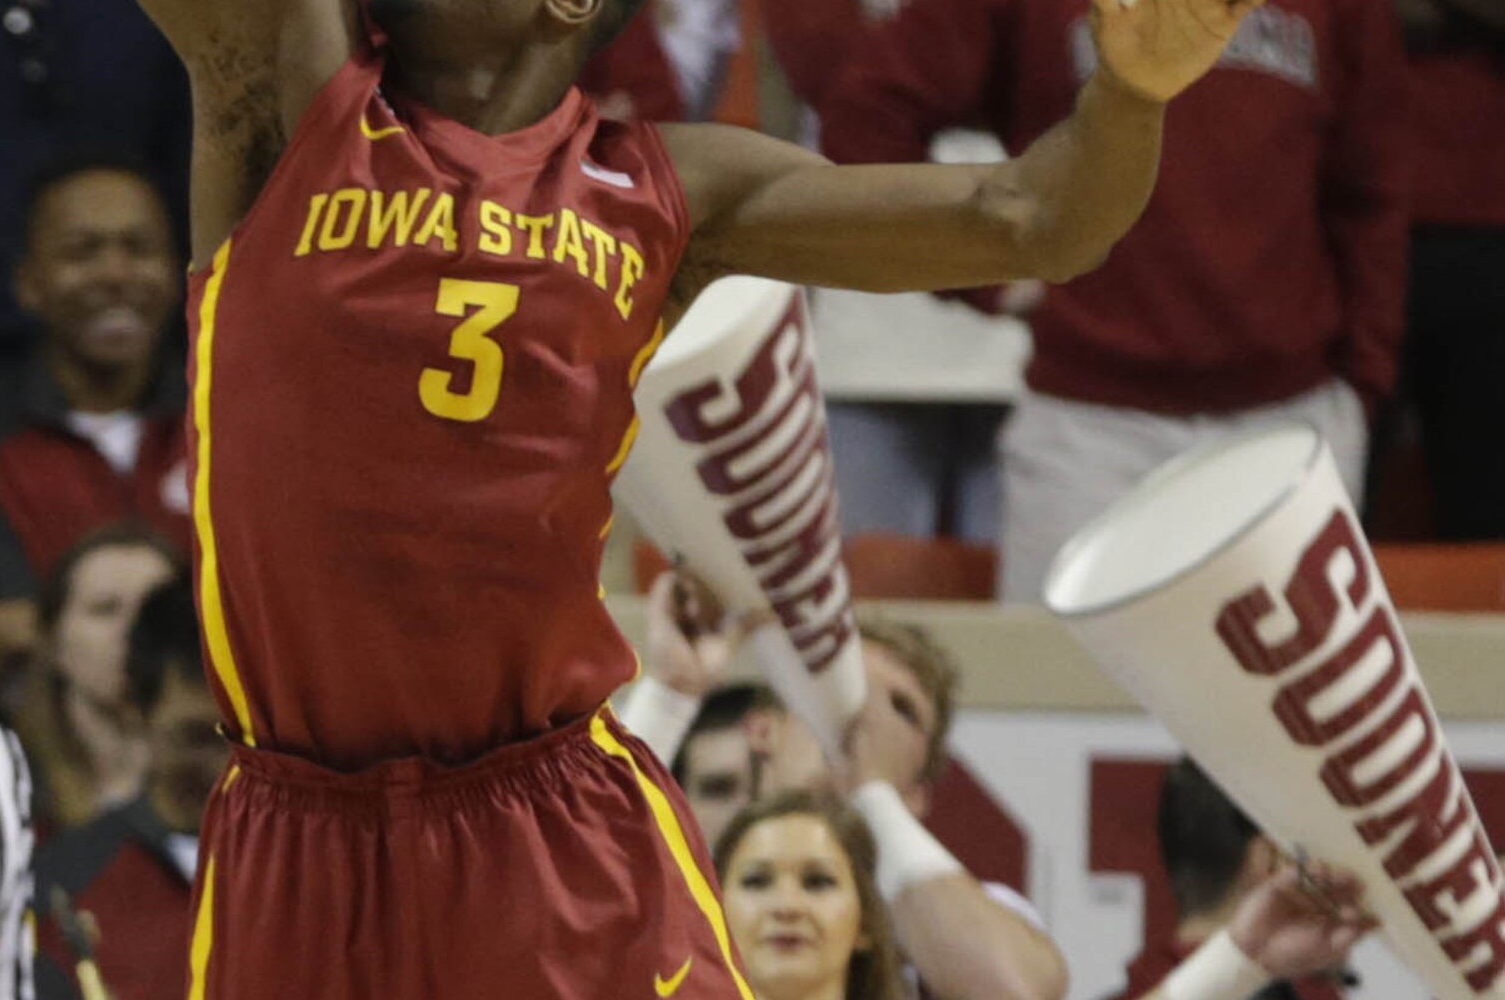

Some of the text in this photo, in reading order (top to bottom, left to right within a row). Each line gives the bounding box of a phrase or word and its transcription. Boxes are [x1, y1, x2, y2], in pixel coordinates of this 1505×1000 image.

[294, 187, 645, 322] IOWA STATE
[418, 277, 521, 423] 3
